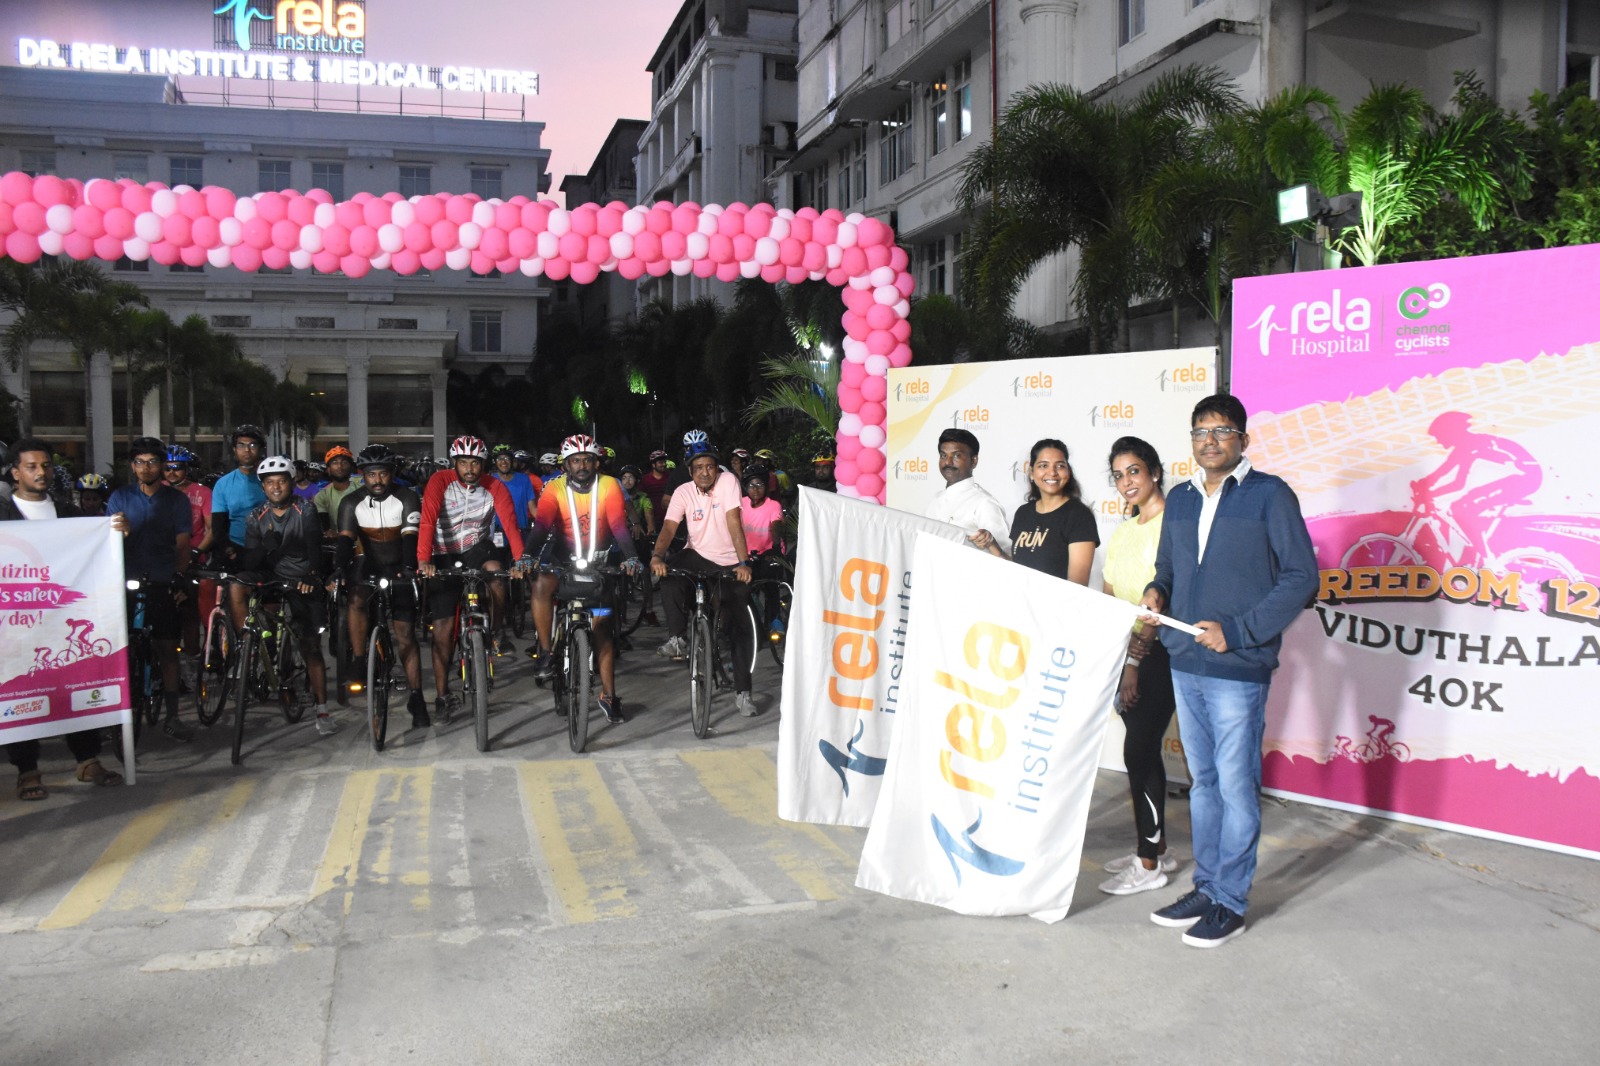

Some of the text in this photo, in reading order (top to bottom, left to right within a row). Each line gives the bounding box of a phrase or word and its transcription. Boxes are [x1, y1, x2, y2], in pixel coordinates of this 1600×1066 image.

[276, 0, 366, 37] rela
[277, 33, 364, 53] institute
[18, 38, 538, 95] DR. RELA INSTITUTE & MEDICAL CENTRE
[1290, 288, 1371, 335] rela
[1396, 322, 1451, 336] chennai
[1291, 333, 1371, 358] Hospital
[1395, 335, 1451, 351] cyclists
[1024, 371, 1052, 389] rela
[1173, 363, 1206, 382] rela
[905, 378, 930, 394] rela
[963, 405, 989, 422] rela
[1103, 400, 1134, 419] rela
[904, 456, 928, 473] rela
[1014, 526, 1049, 554] RUN
[2, 563, 51, 581] tizing
[13, 586, 63, 605] safety
[1318, 565, 1523, 607] REEDOM
[8, 611, 43, 628] day!
[823, 557, 890, 712] rela
[1409, 674, 1504, 712] 40K
[933, 620, 1031, 800] rela
[1007, 646, 1076, 814] institute
